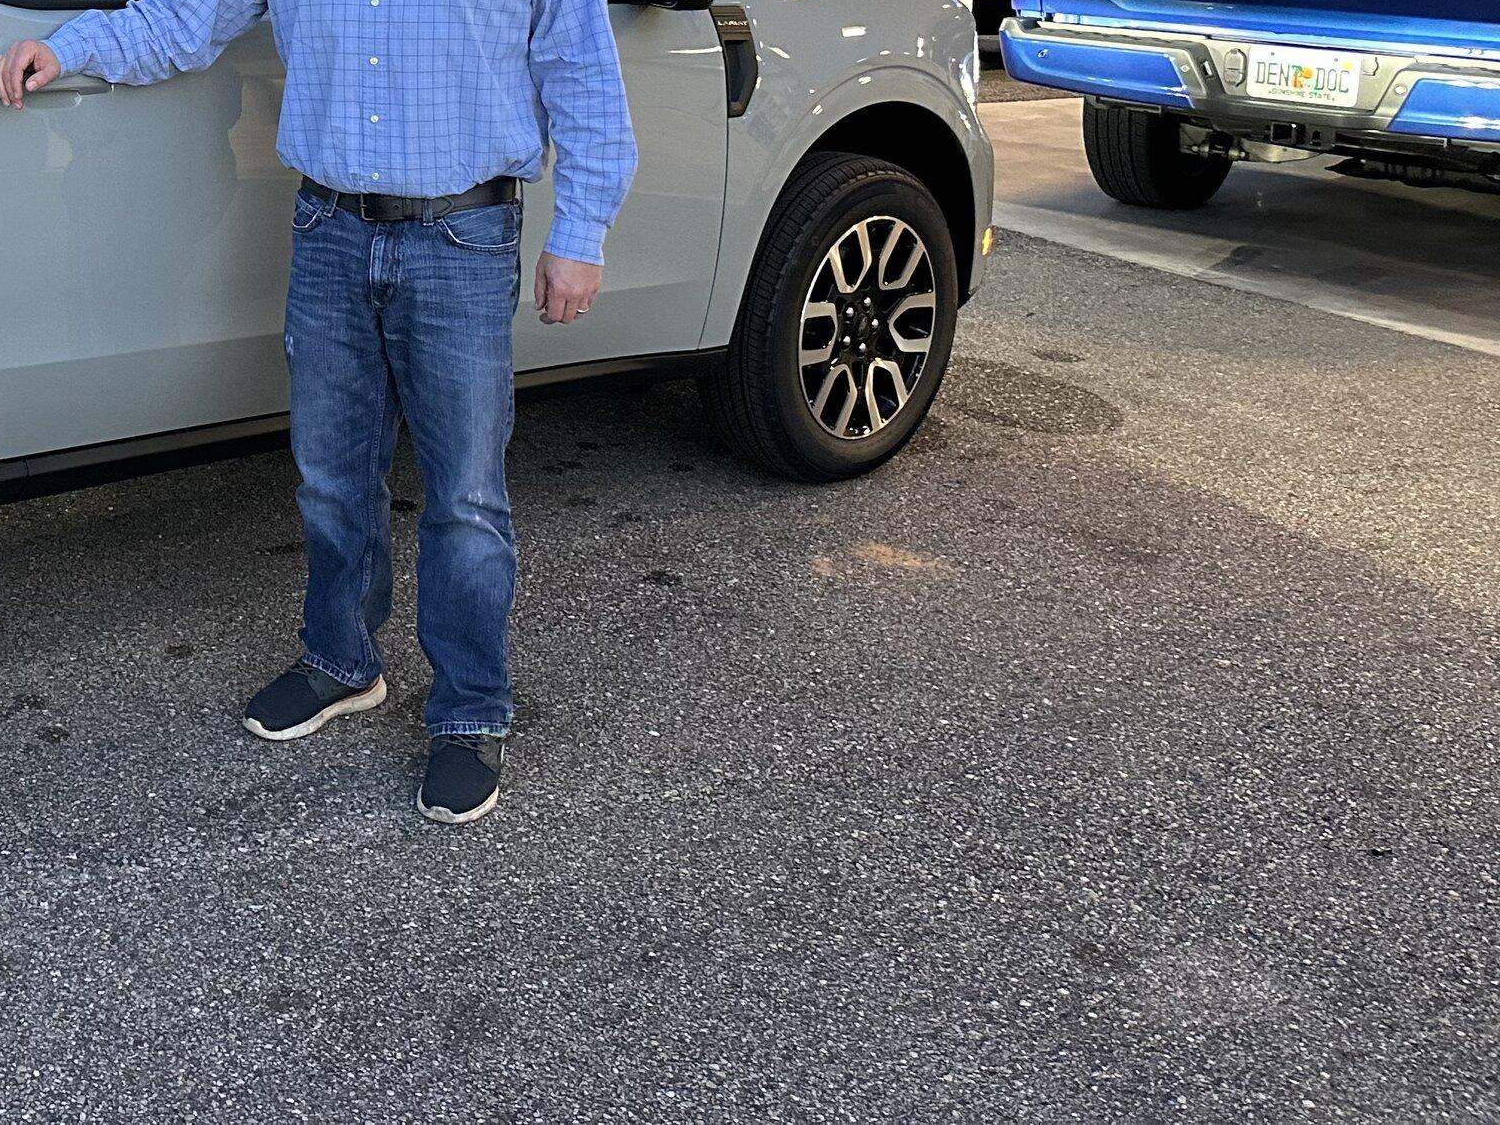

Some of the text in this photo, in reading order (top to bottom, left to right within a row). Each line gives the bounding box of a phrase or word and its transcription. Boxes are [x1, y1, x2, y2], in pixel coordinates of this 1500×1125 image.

[1255, 62, 1350, 93] DENT DOC
[1309, 91, 1331, 101] STATE
